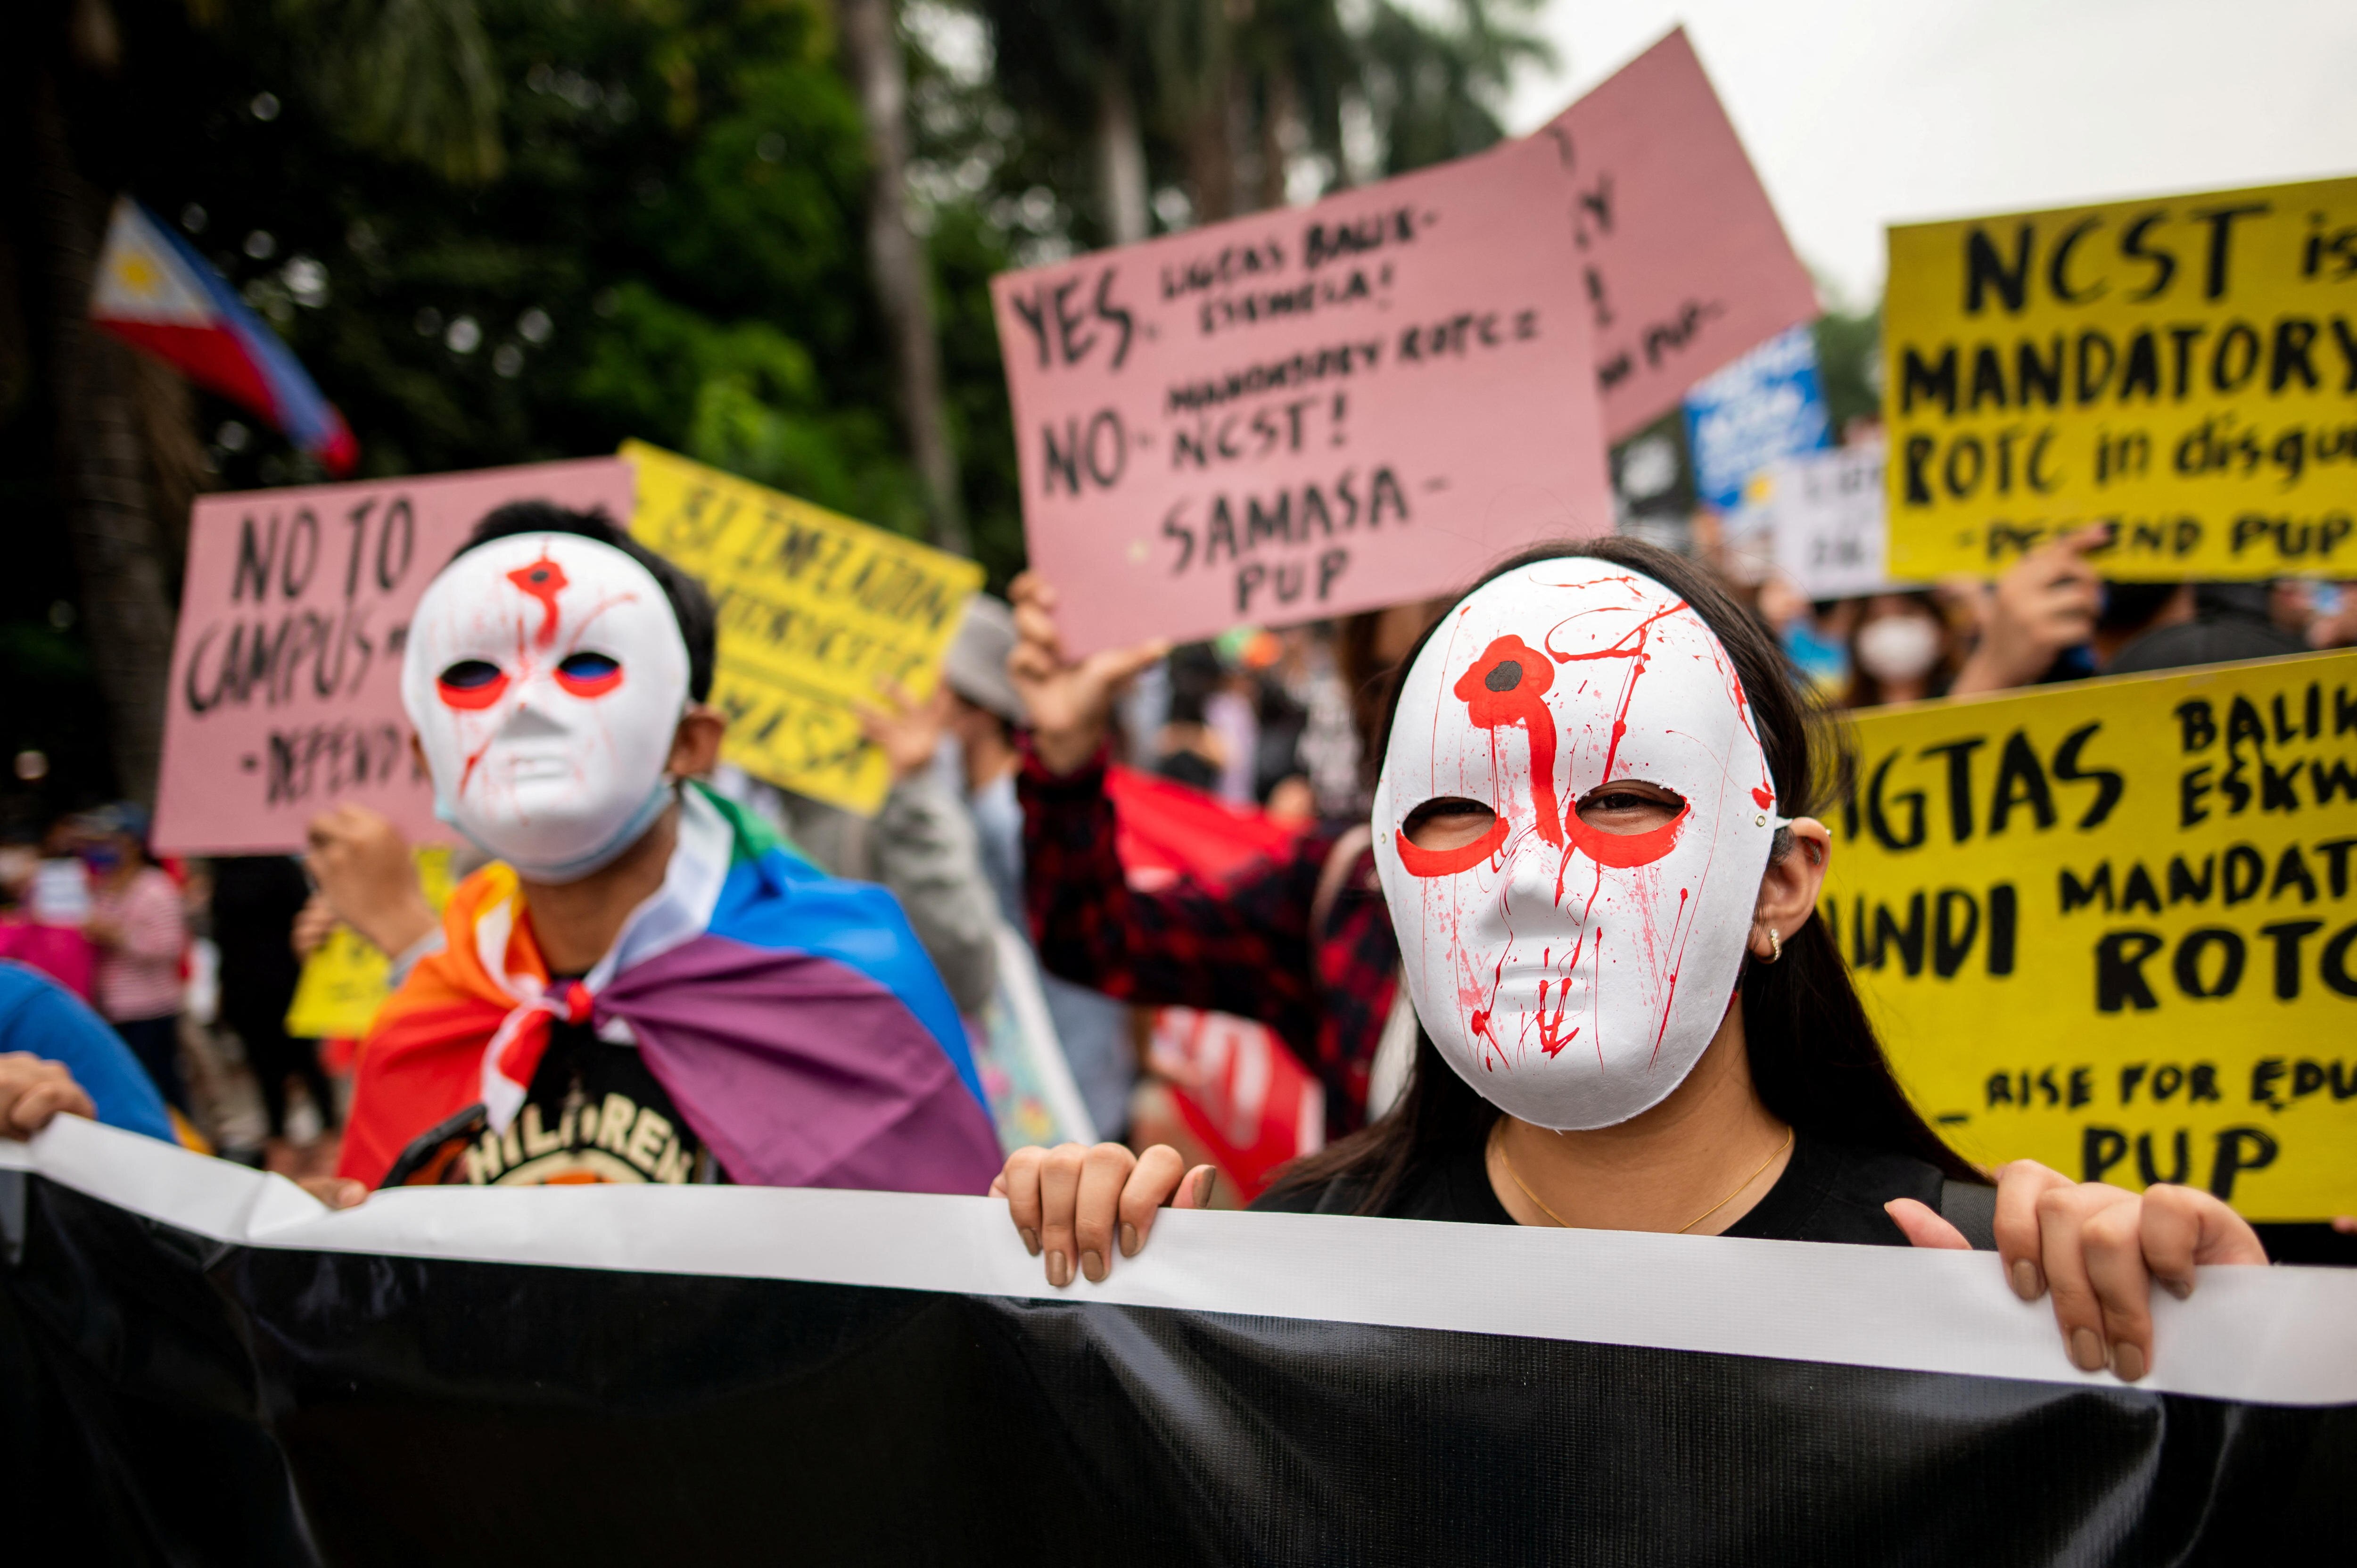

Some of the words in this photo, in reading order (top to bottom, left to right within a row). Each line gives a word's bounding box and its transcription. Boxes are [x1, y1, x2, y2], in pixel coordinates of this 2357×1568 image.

[1963, 200, 2272, 319] NCST
[2299, 210, 2357, 281] is
[1900, 319, 2357, 419] MANDATORY
[1902, 424, 2064, 510] ROTC
[2092, 421, 2151, 488] in
[231, 506, 320, 605] NO
[346, 494, 414, 601] TO
[1236, 548, 1352, 612] PUP
[2230, 508, 2355, 561] PUP
[185, 604, 375, 715] CAMPUS
[1841, 719, 2125, 854] IGTAS
[2058, 837, 2357, 916] MANDAT
[1825, 883, 2019, 982] INDI
[2094, 914, 2357, 1015] ROTC
[1984, 1065, 2094, 1111] RISE
[2118, 1060, 2223, 1106] FOR
[464, 1092, 694, 1184] HILDREN
[2082, 1121, 2280, 1201] PUP
